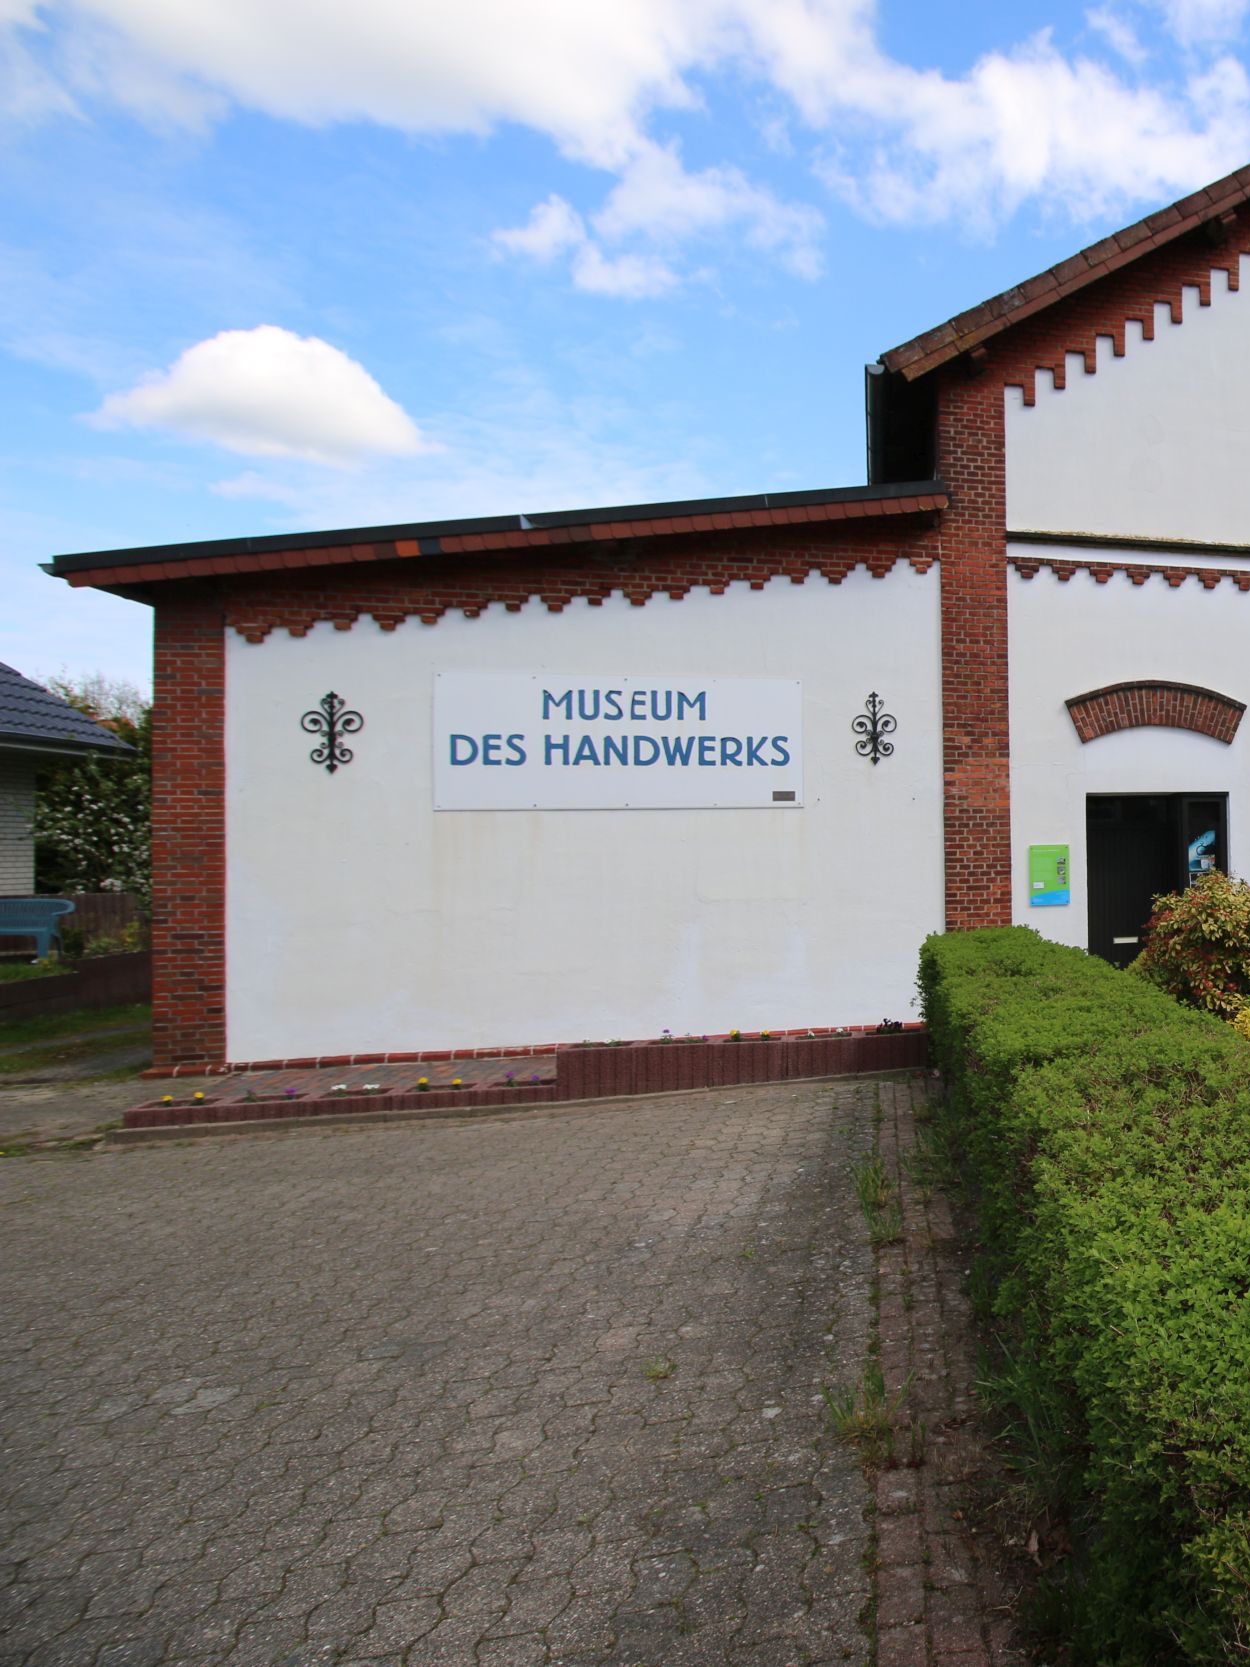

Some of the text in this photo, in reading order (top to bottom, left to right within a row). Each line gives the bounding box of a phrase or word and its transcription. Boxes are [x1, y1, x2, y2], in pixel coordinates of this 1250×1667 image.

[541, 689, 707, 721] MUSEUM
[449, 733, 791, 767] DES HANDWERKS
